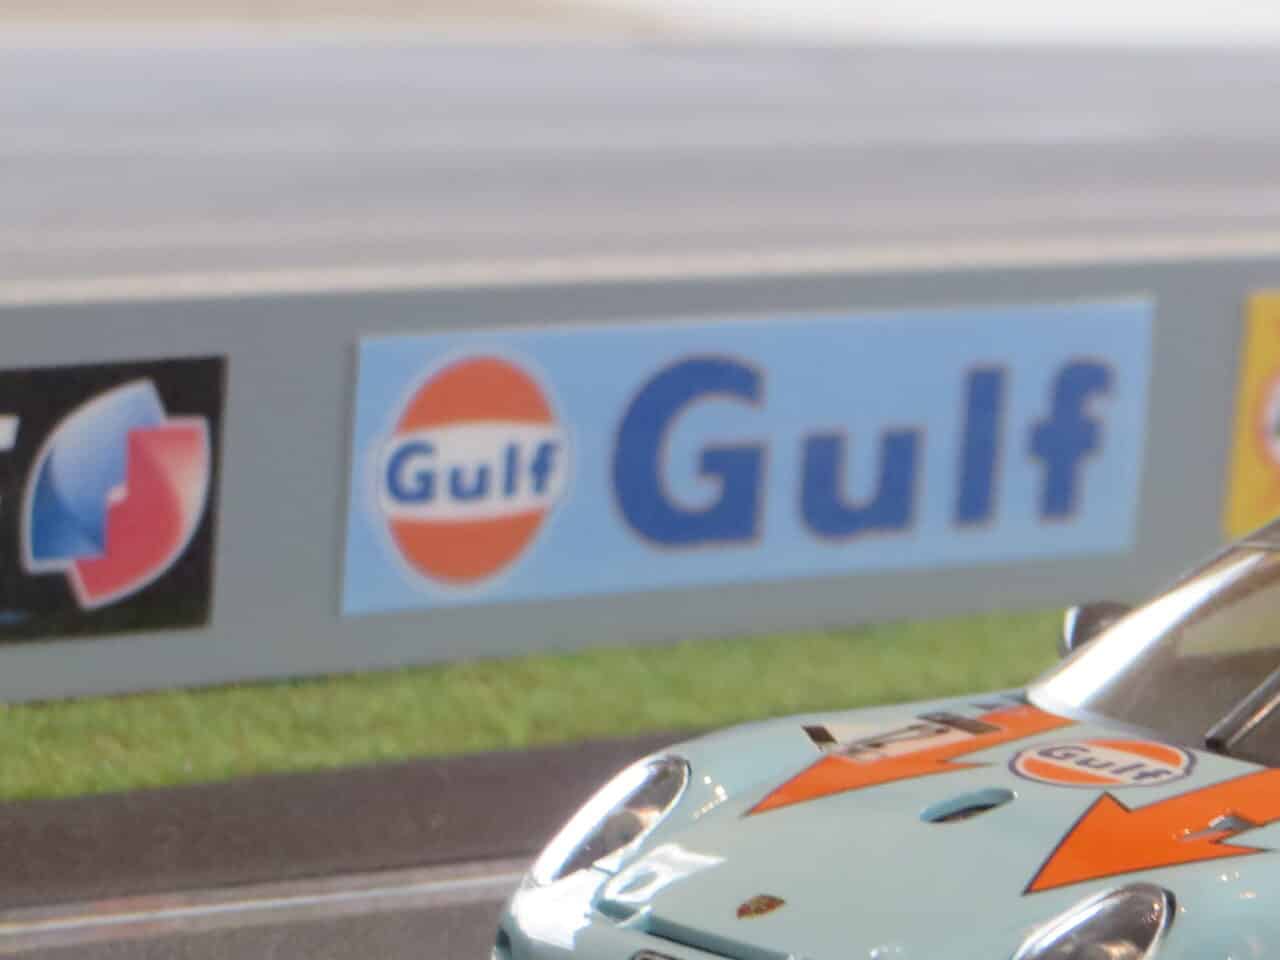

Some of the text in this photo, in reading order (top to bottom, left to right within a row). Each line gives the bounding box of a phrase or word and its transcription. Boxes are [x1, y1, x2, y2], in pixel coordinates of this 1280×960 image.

[385, 439, 560, 505] Gulf
[611, 353, 1116, 550] Gulf
[1036, 744, 1174, 781] Gulf
